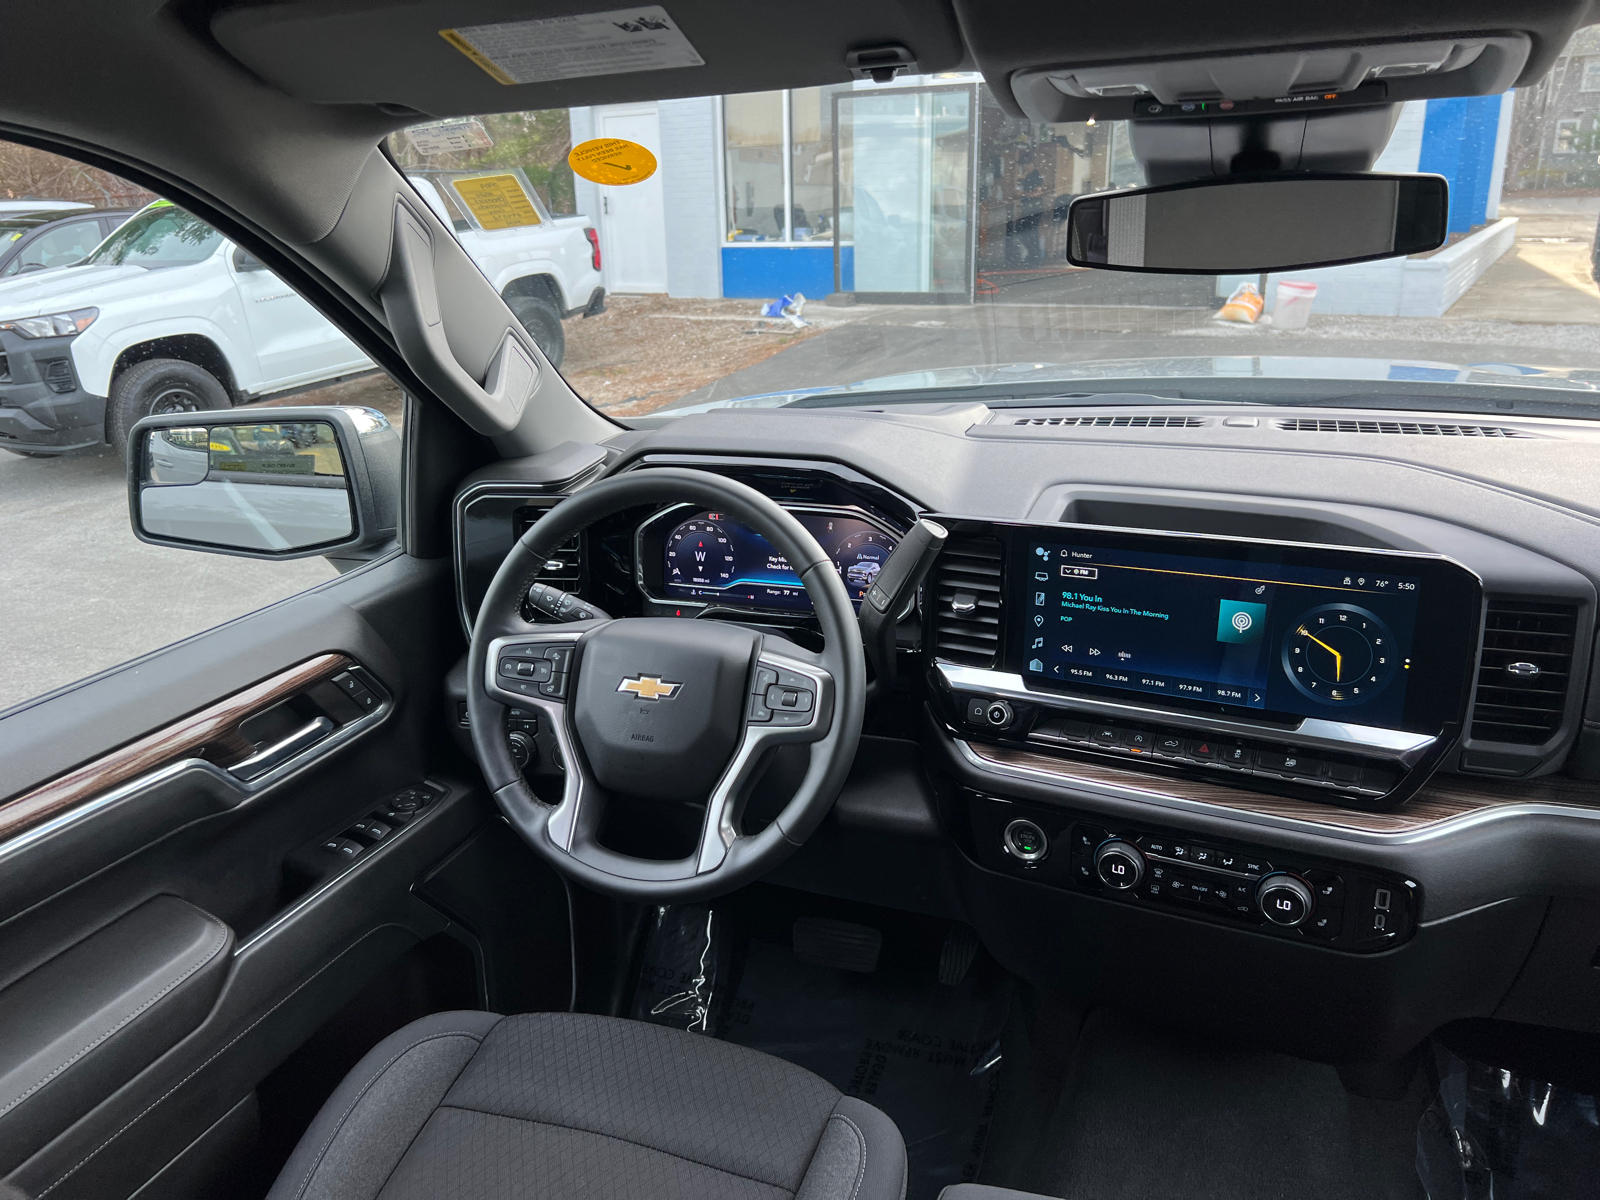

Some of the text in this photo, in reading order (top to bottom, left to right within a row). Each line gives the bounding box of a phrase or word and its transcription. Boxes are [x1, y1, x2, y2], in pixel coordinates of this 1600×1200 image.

[694, 552, 706, 562] W
[1062, 591, 1078, 600] 98.1
[1079, 593, 1093, 602] You
[1061, 601, 1084, 610] Michael
[1085, 604, 1096, 612] Ray
[1143, 610, 1169, 620] Morning
[630, 733, 654, 742] AIRBAG
